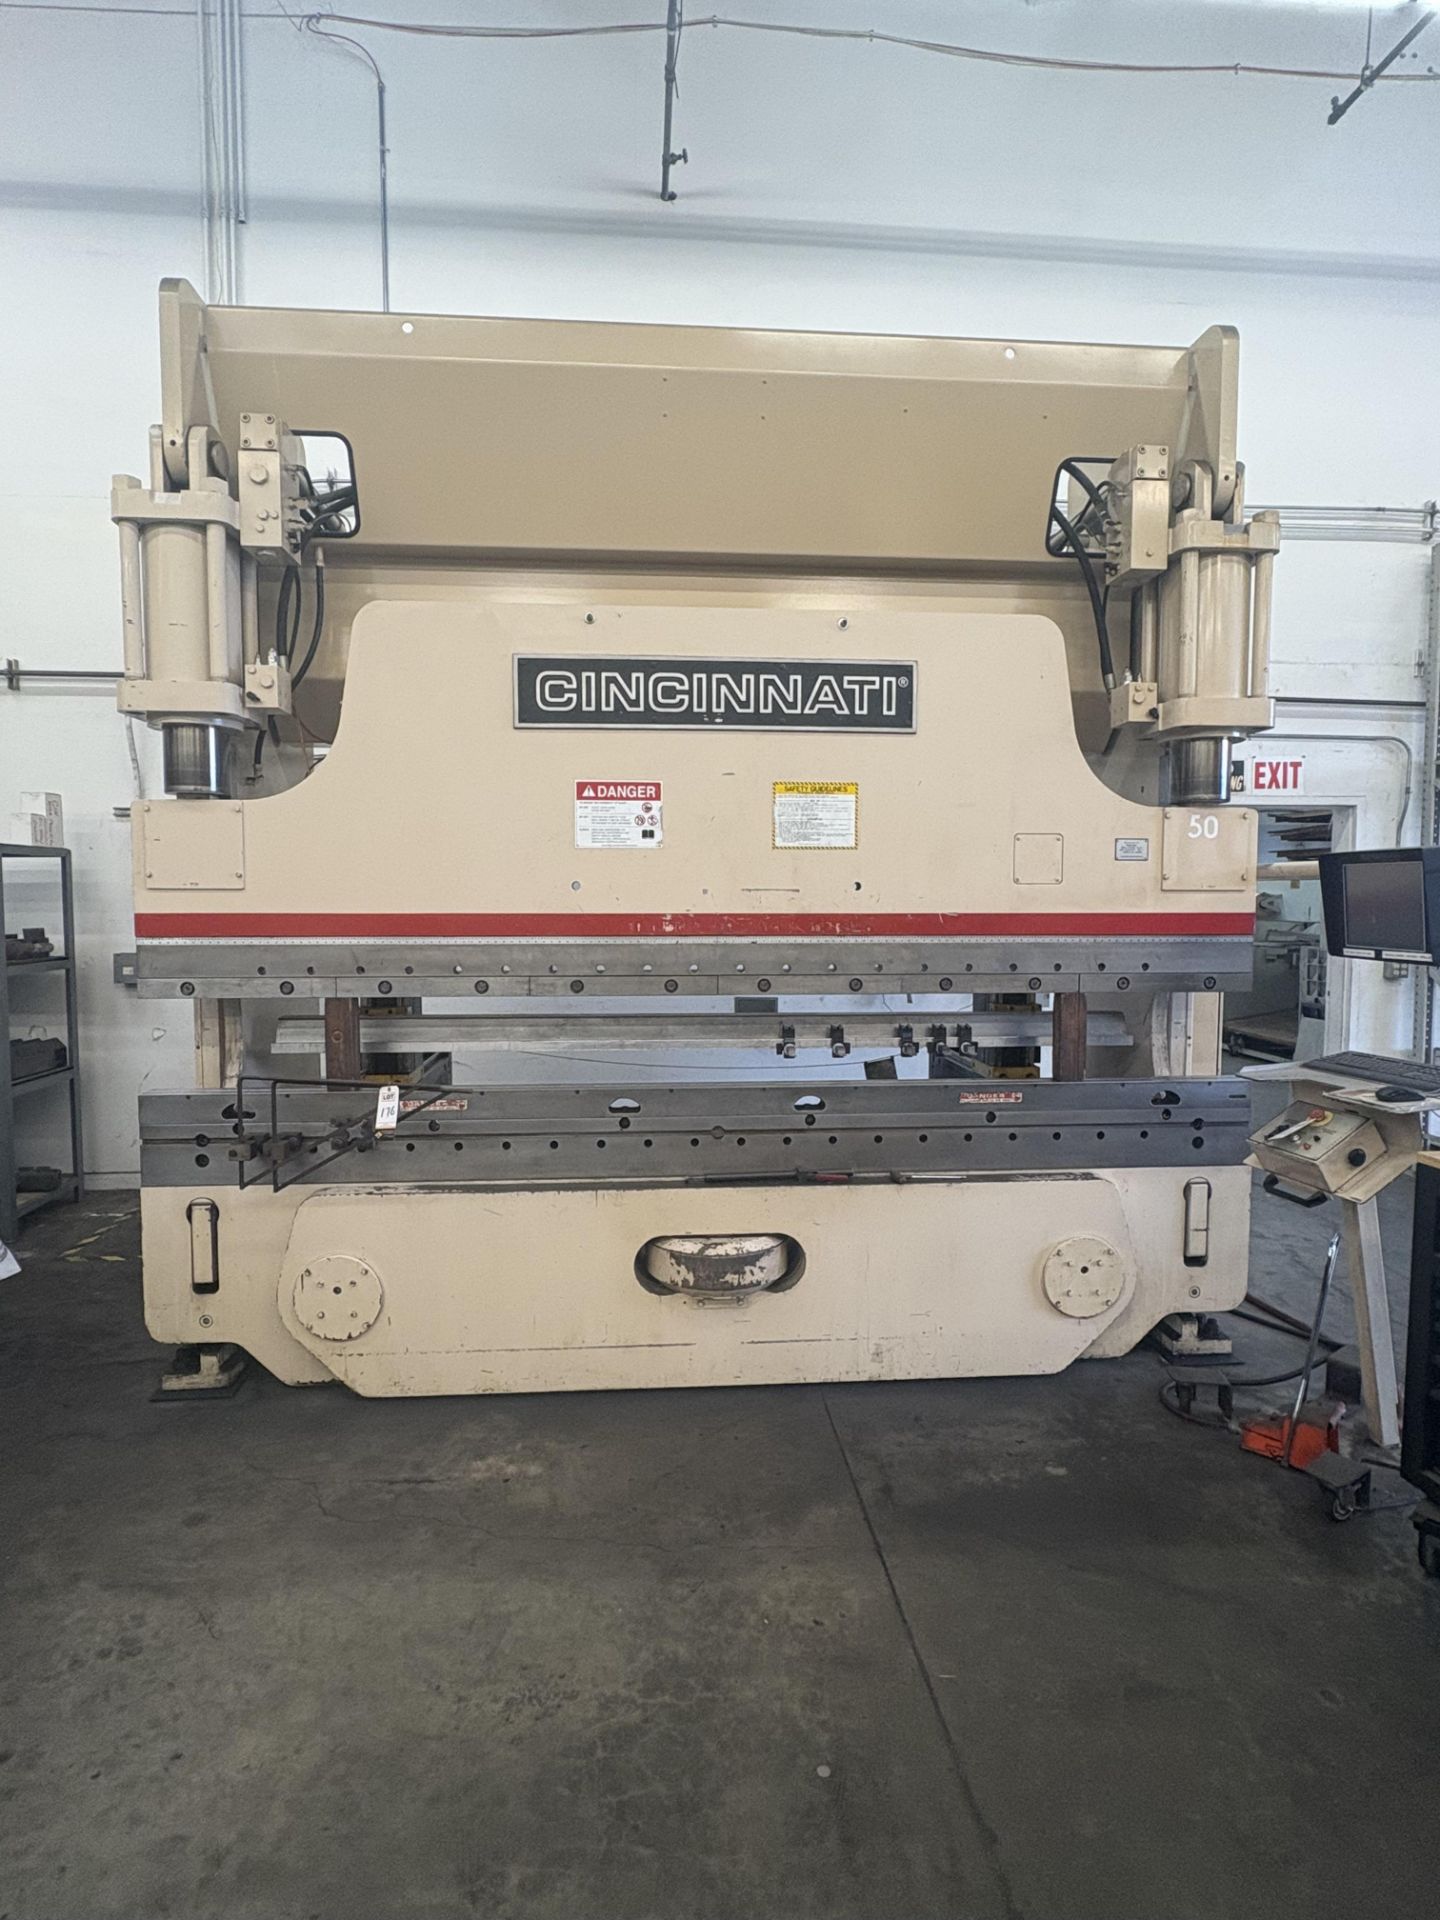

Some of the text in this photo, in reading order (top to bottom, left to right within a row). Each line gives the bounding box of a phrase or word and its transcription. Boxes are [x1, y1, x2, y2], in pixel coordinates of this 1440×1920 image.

[1254, 761, 1302, 789] EXIT
[597, 785, 656, 798] DANGER
[1188, 815, 1219, 839] 50
[382, 1093, 395, 1101] LOT
[380, 1105, 395, 1118] 176
